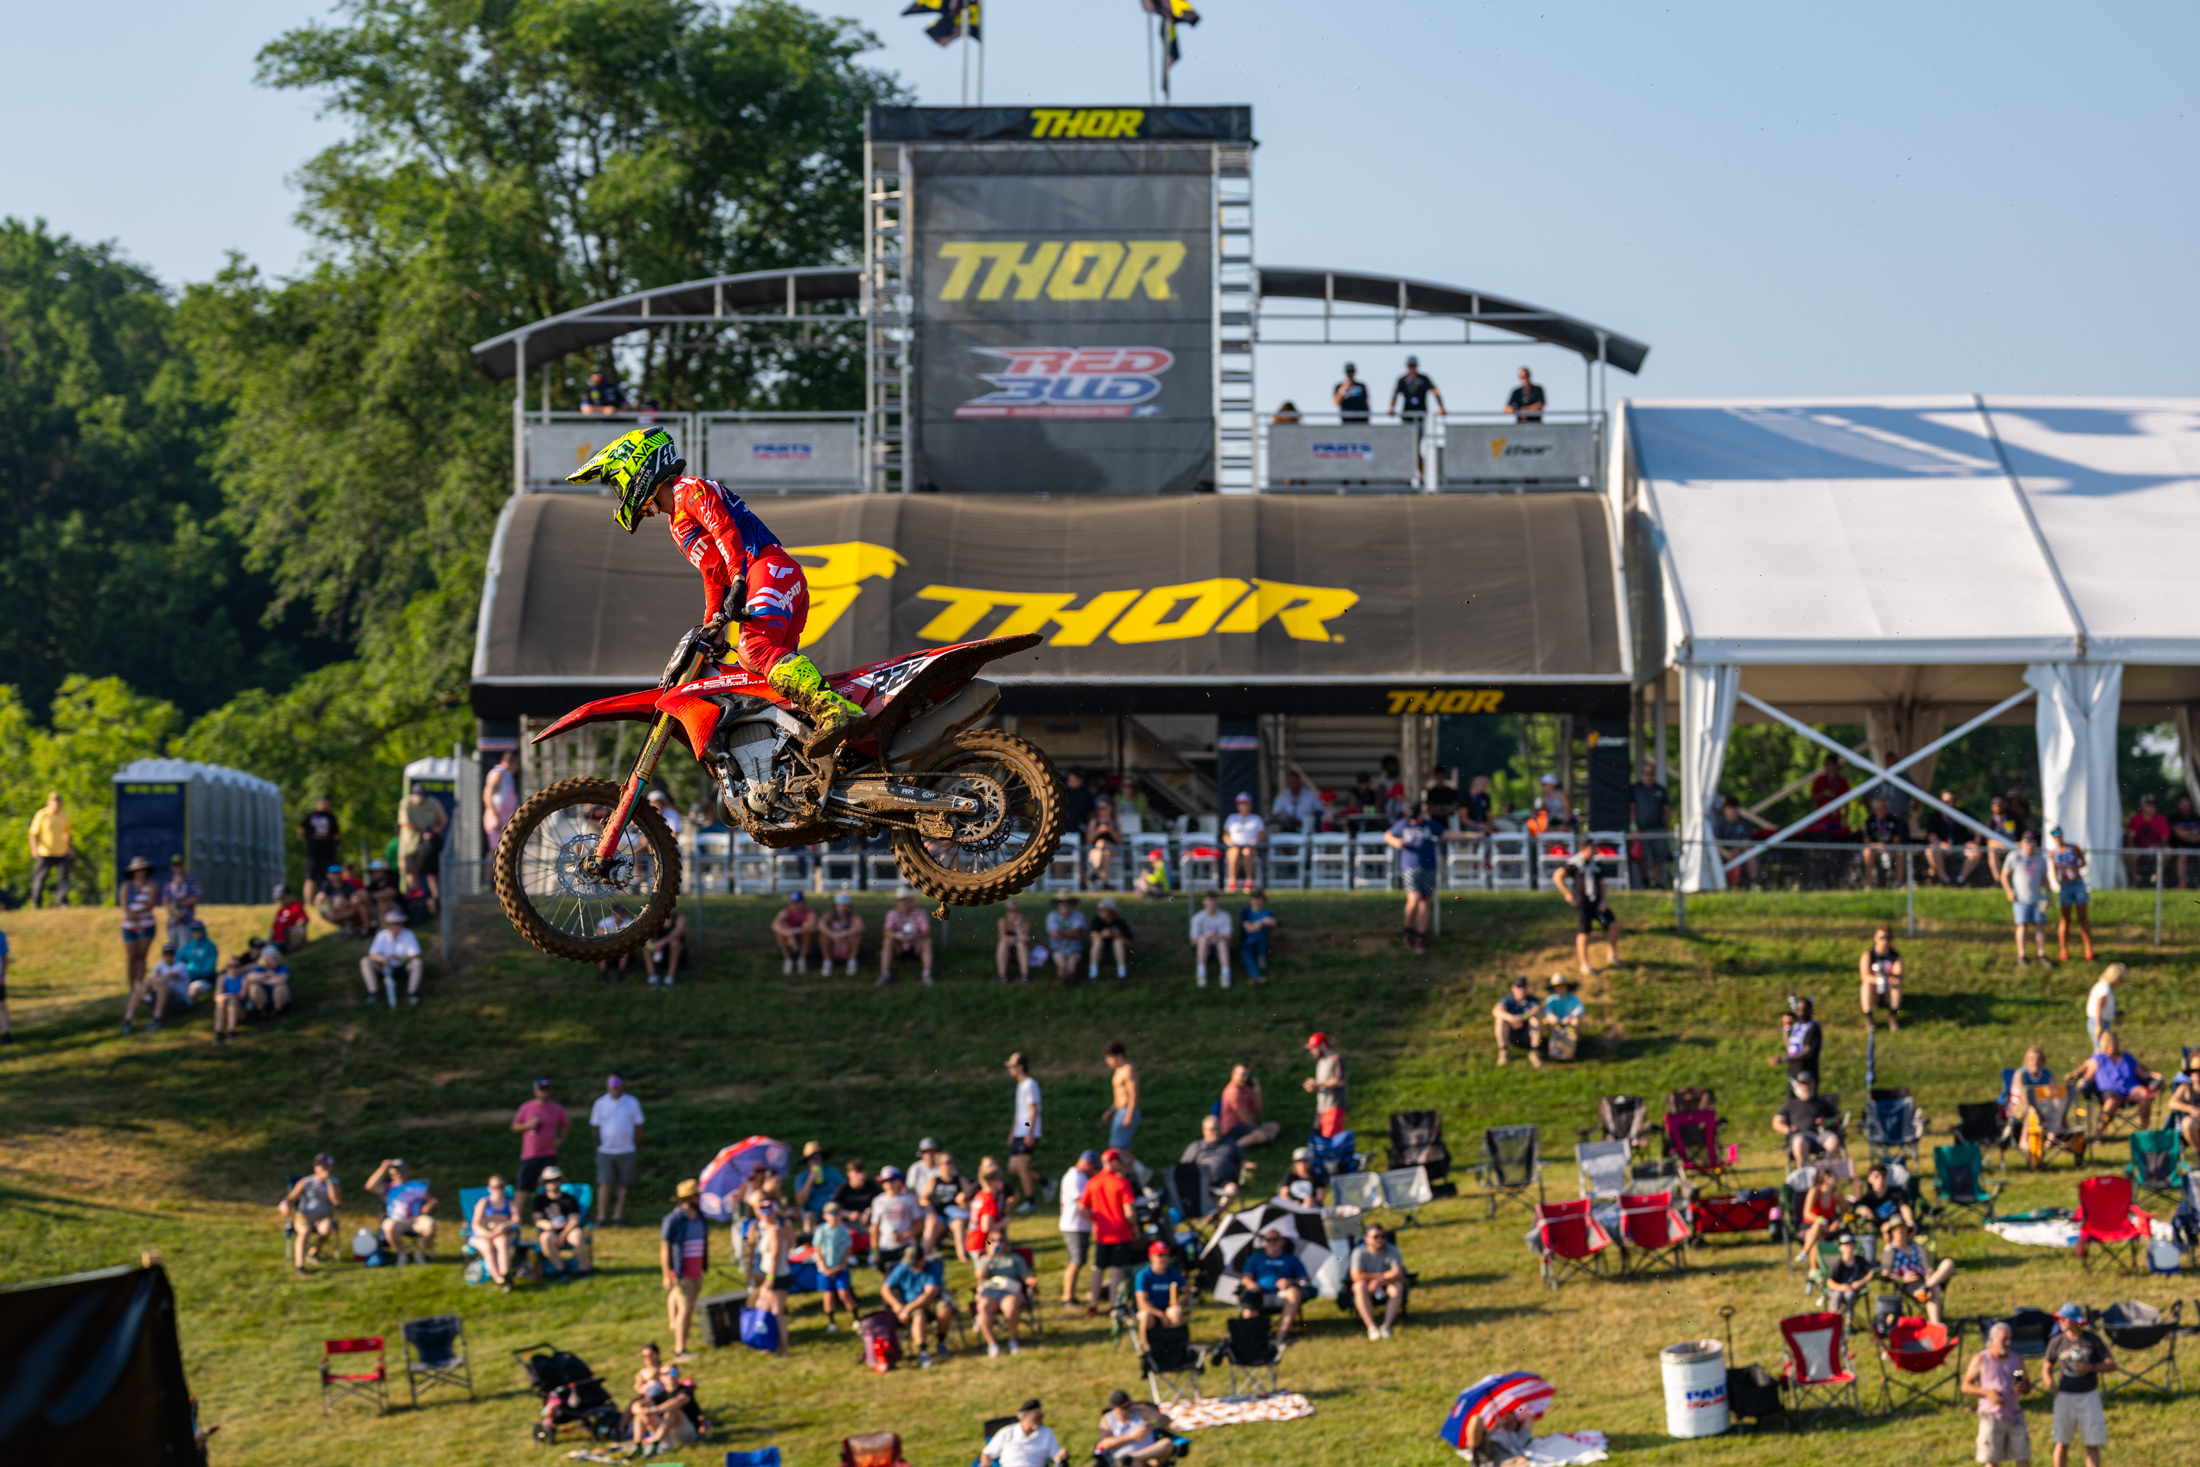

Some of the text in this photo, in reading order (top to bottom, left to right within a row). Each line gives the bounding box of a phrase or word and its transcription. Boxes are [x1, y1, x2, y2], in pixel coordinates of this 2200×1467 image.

[1030, 109, 1145, 138] THOR
[937, 240, 1188, 300] THOR
[968, 346, 1175, 375] RED
[966, 374, 1161, 405] BUD
[689, 538, 708, 569] CATI
[778, 580, 802, 612] DUCATI
[917, 577, 1361, 647] THOR
[680, 676, 748, 693] 450
[834, 683, 856, 696] ORSE
[1387, 689, 1504, 715] THOR
[1686, 1384, 1728, 1401] PAR
